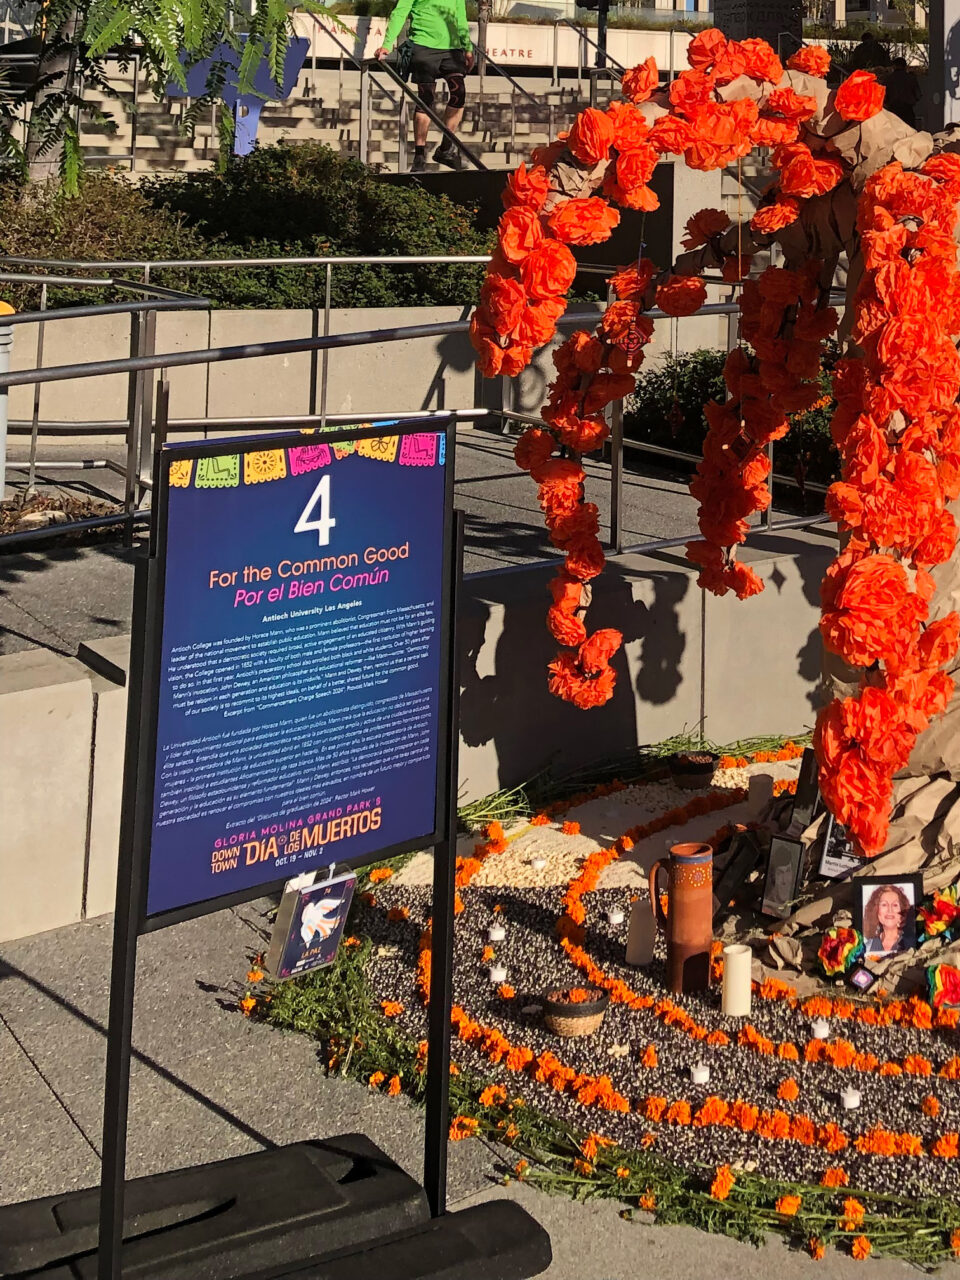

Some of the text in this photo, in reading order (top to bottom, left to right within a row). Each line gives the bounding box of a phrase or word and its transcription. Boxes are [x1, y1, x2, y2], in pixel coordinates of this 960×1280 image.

[294, 475, 336, 547] 4
[209, 541, 408, 589] For the Common Good
[233, 564, 389, 608] Por el Bien Común
[262, 598, 362, 623] Antioch University Los Angeles
[214, 796, 380, 849] GLORIA MOLINA GRAND PARK'S
[242, 806, 381, 866] DÍA DE LOS MUERTOS
[210, 856, 237, 874] TOWN
[211, 844, 240, 863] DOWN
[274, 856, 287, 867] OCT.
[289, 853, 296, 863] 19
[303, 847, 318, 859] NOV.
[319, 846, 323, 855] 2
